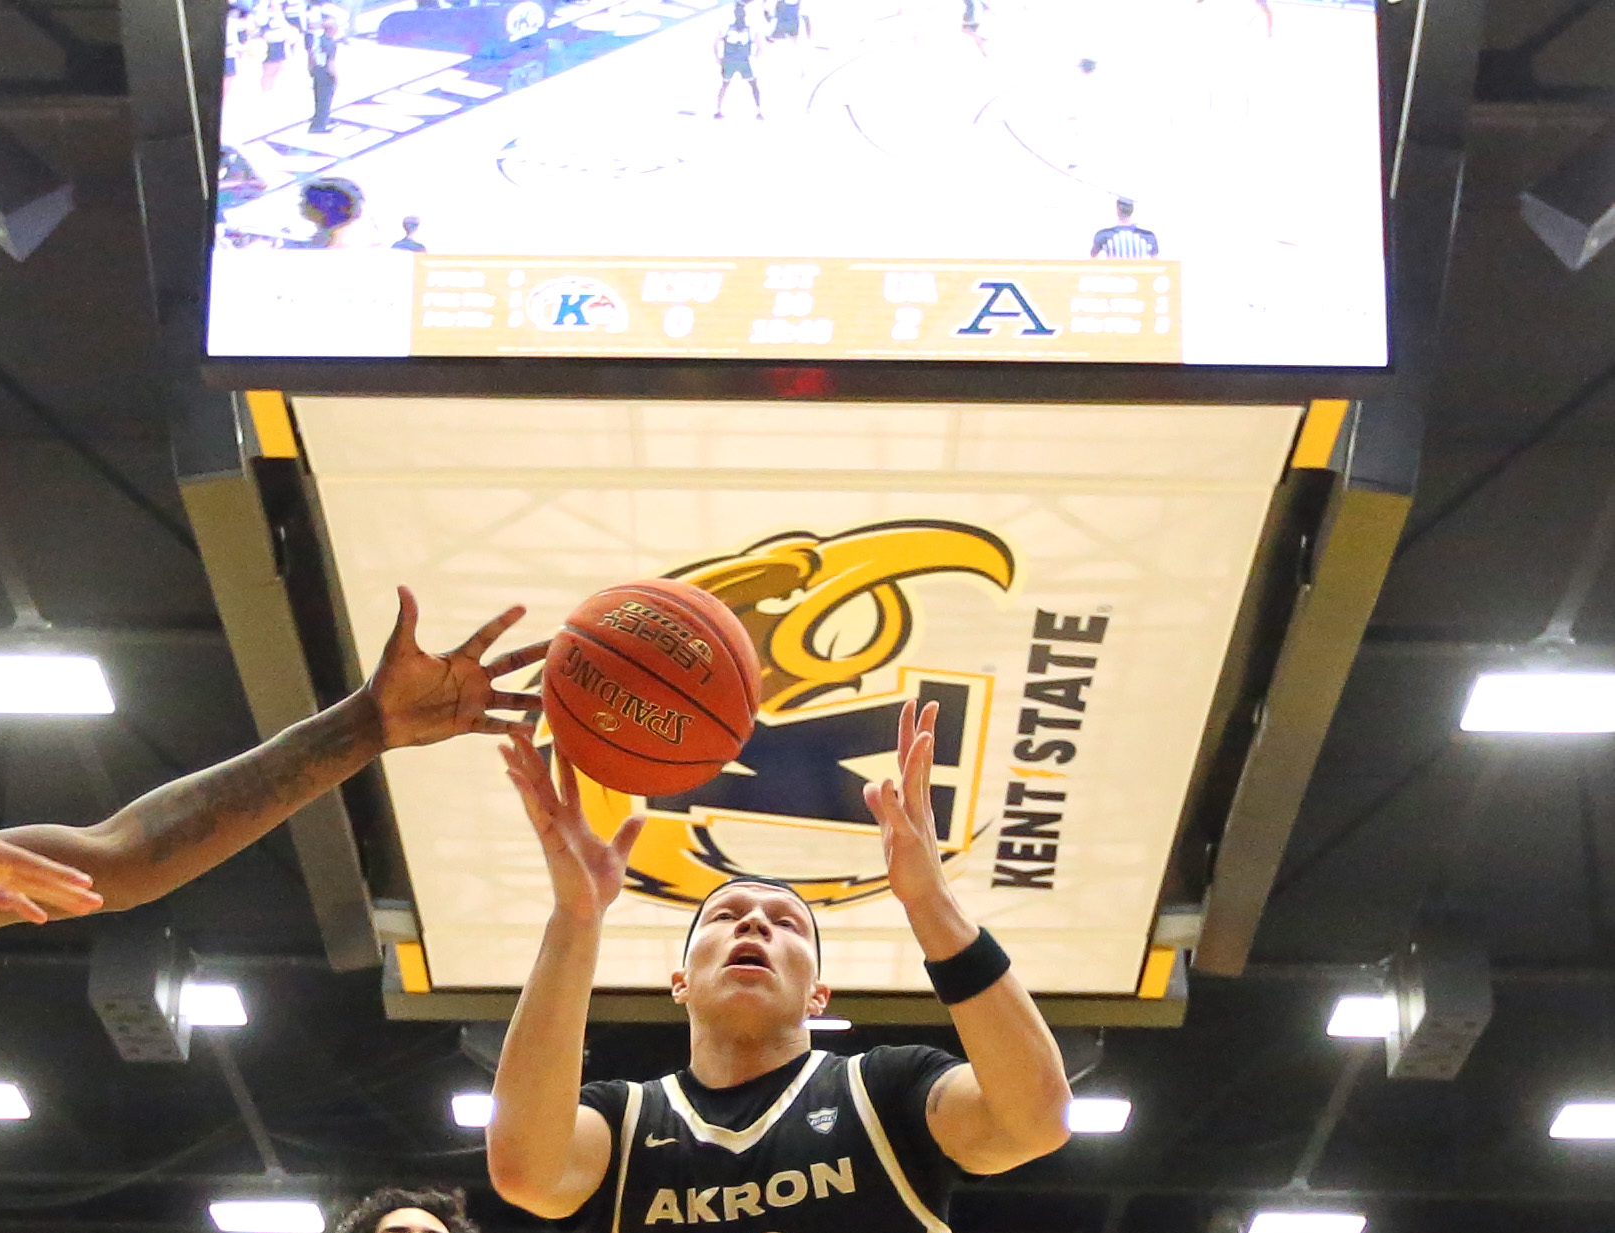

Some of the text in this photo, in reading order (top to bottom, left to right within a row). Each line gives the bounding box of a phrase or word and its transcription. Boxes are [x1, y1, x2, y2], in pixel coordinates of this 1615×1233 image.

[956, 282, 1056, 336] A
[597, 609, 713, 686] LEGACY
[561, 644, 695, 745] SPALDING
[990, 608, 1110, 890] KENT STATE
[644, 1157, 856, 1225] AKRON
